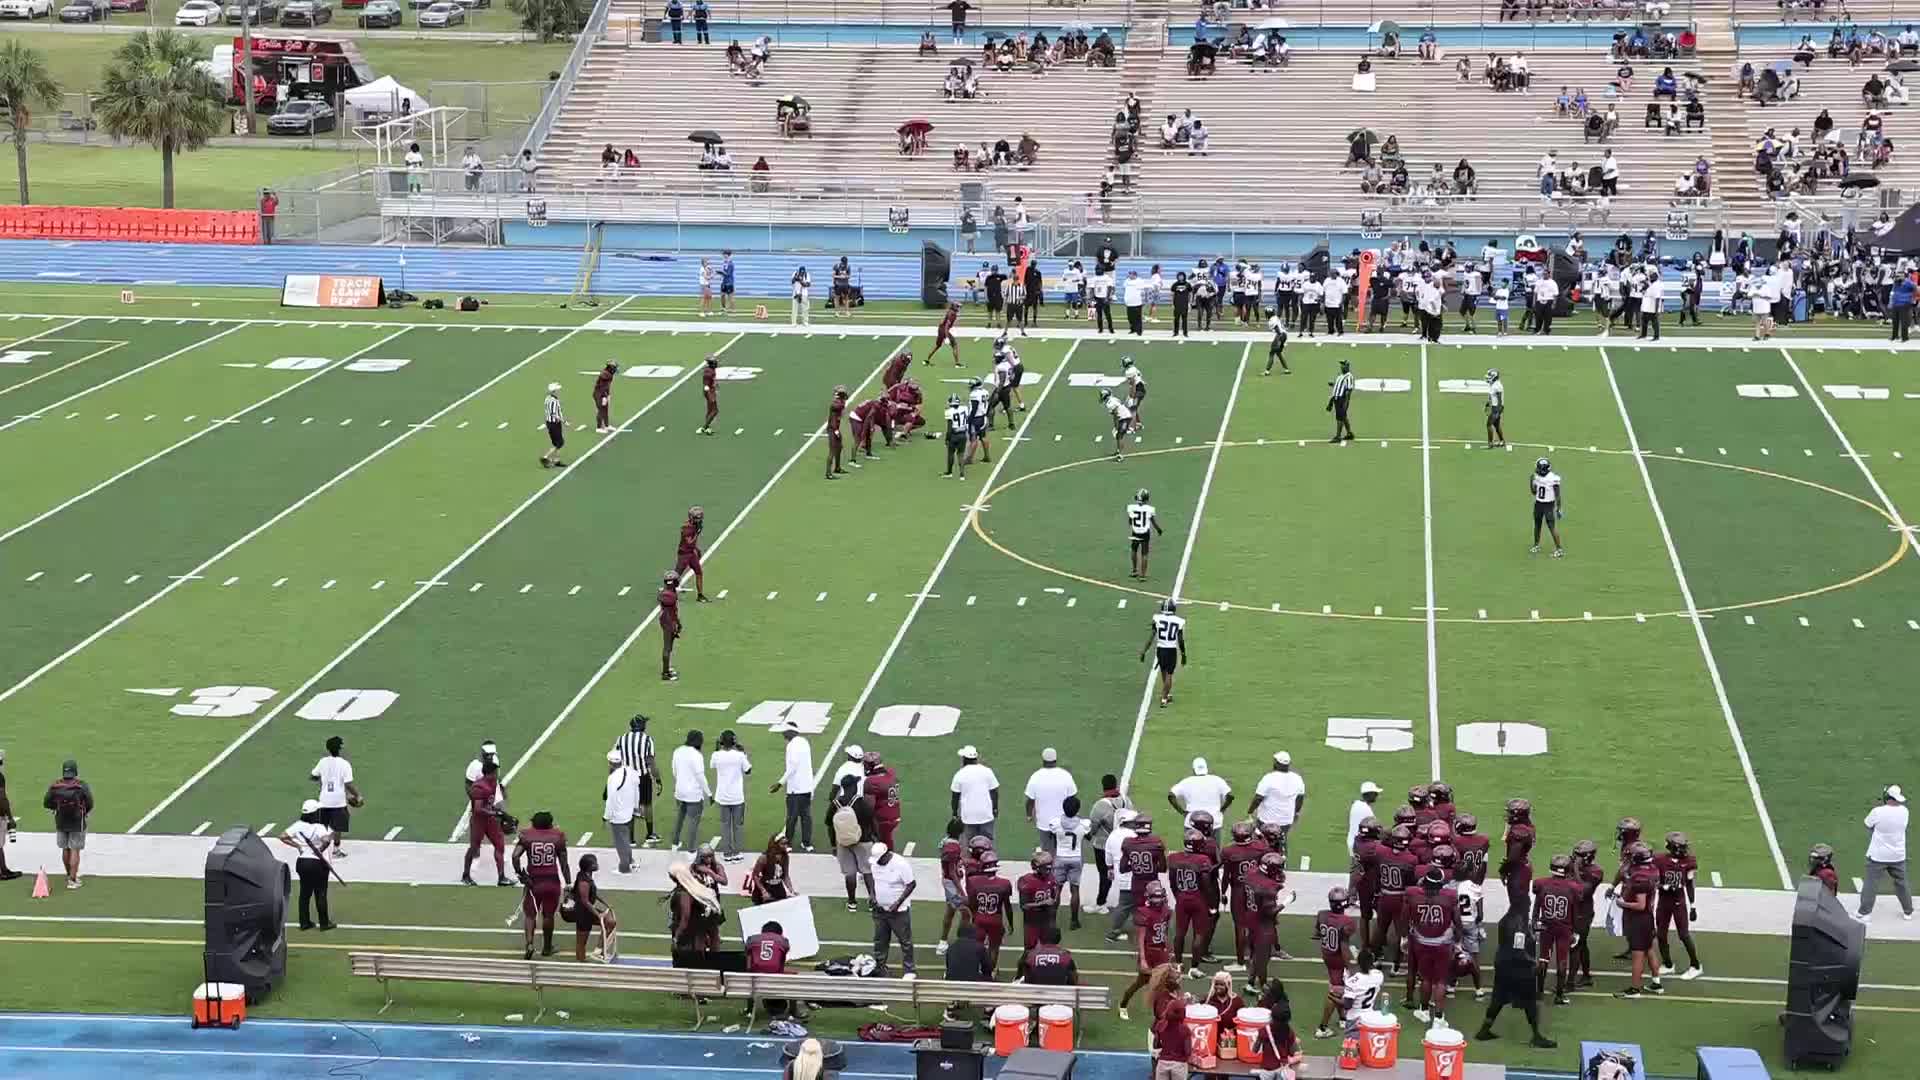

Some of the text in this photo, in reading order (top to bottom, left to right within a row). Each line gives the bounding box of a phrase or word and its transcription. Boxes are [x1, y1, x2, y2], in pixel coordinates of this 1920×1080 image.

[953, 411, 968, 427] 97
[1133, 511, 1147, 528] 21
[1158, 620, 1179, 641] 20
[1065, 831, 1077, 851] 7
[531, 842, 556, 866] 52
[1175, 868, 1198, 892] 42
[1380, 863, 1402, 888] 90
[1417, 904, 1443, 926] 78
[1458, 894, 1471, 916] 2
[1544, 894, 1568, 919] 93
[759, 941, 774, 961] 5
[1361, 987, 1376, 1009] 2
[1372, 1035, 1386, 1048] G
[1438, 1052, 1451, 1065] G
